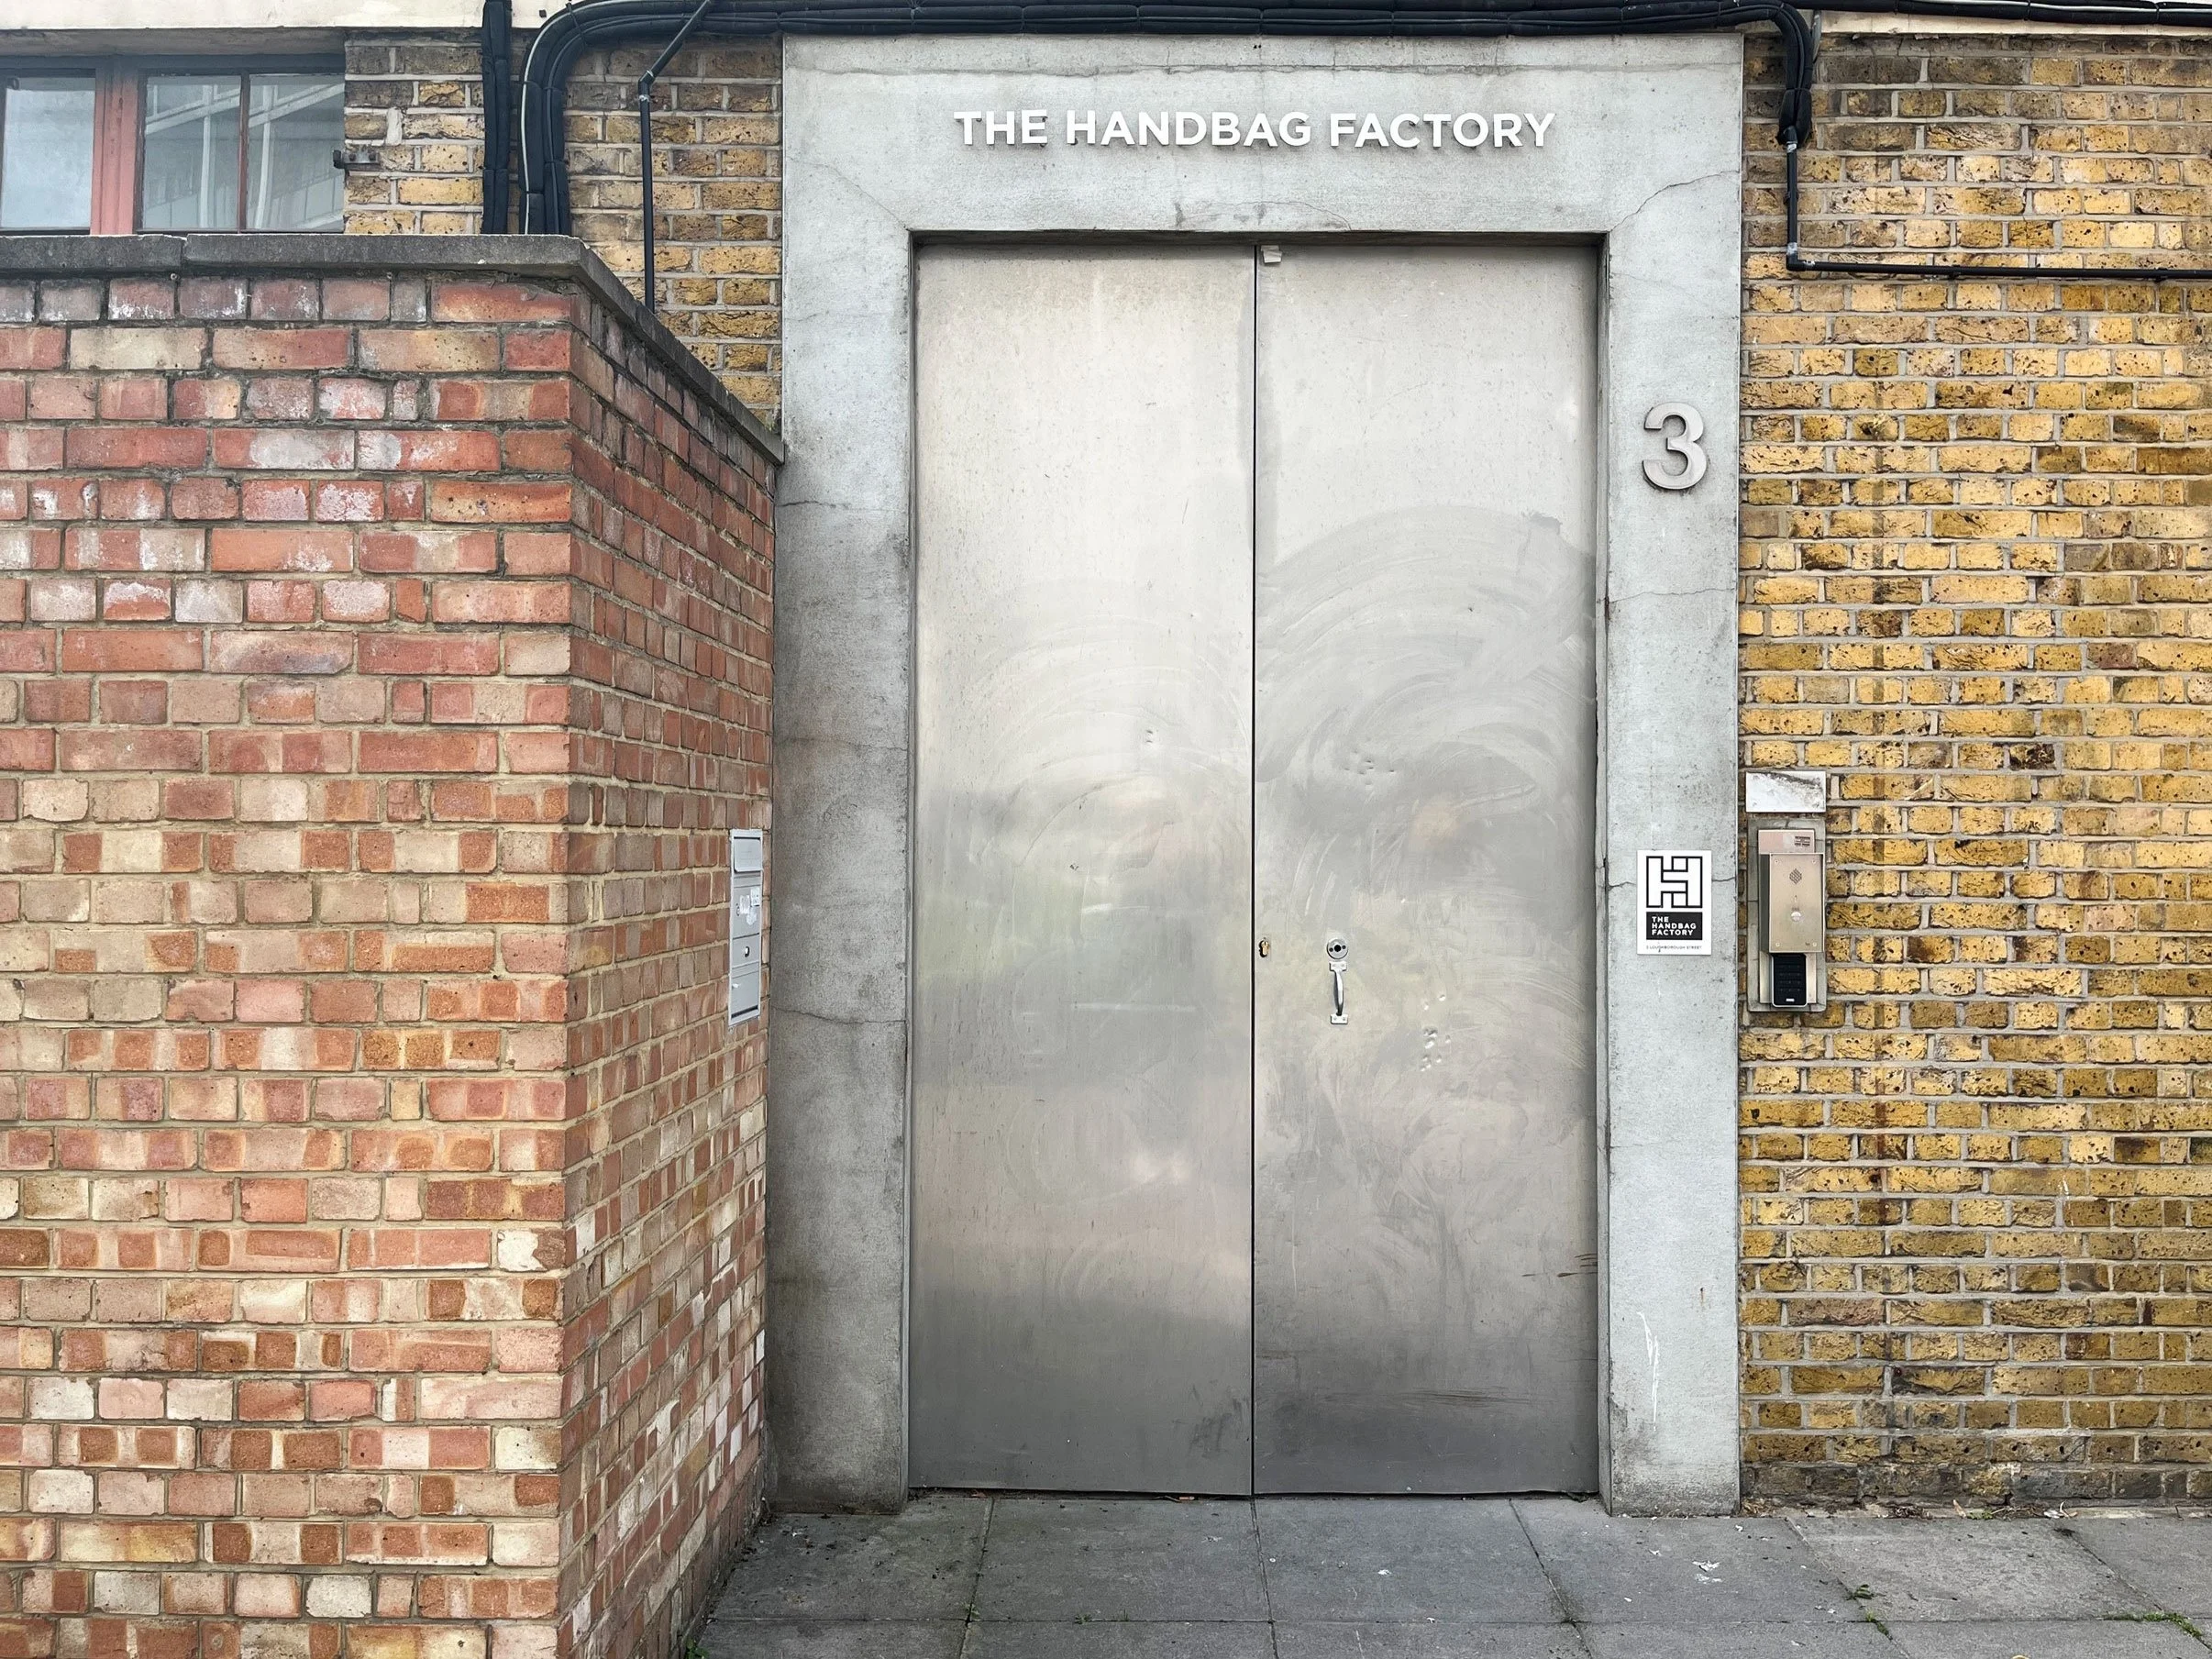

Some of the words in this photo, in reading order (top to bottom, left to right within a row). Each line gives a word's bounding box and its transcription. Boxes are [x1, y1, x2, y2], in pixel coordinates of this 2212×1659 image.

[953, 109, 1048, 145] THE
[1067, 110, 1311, 147] HANDBAG
[1330, 112, 1556, 148] FACTORY
[1642, 402, 1708, 491] 3
